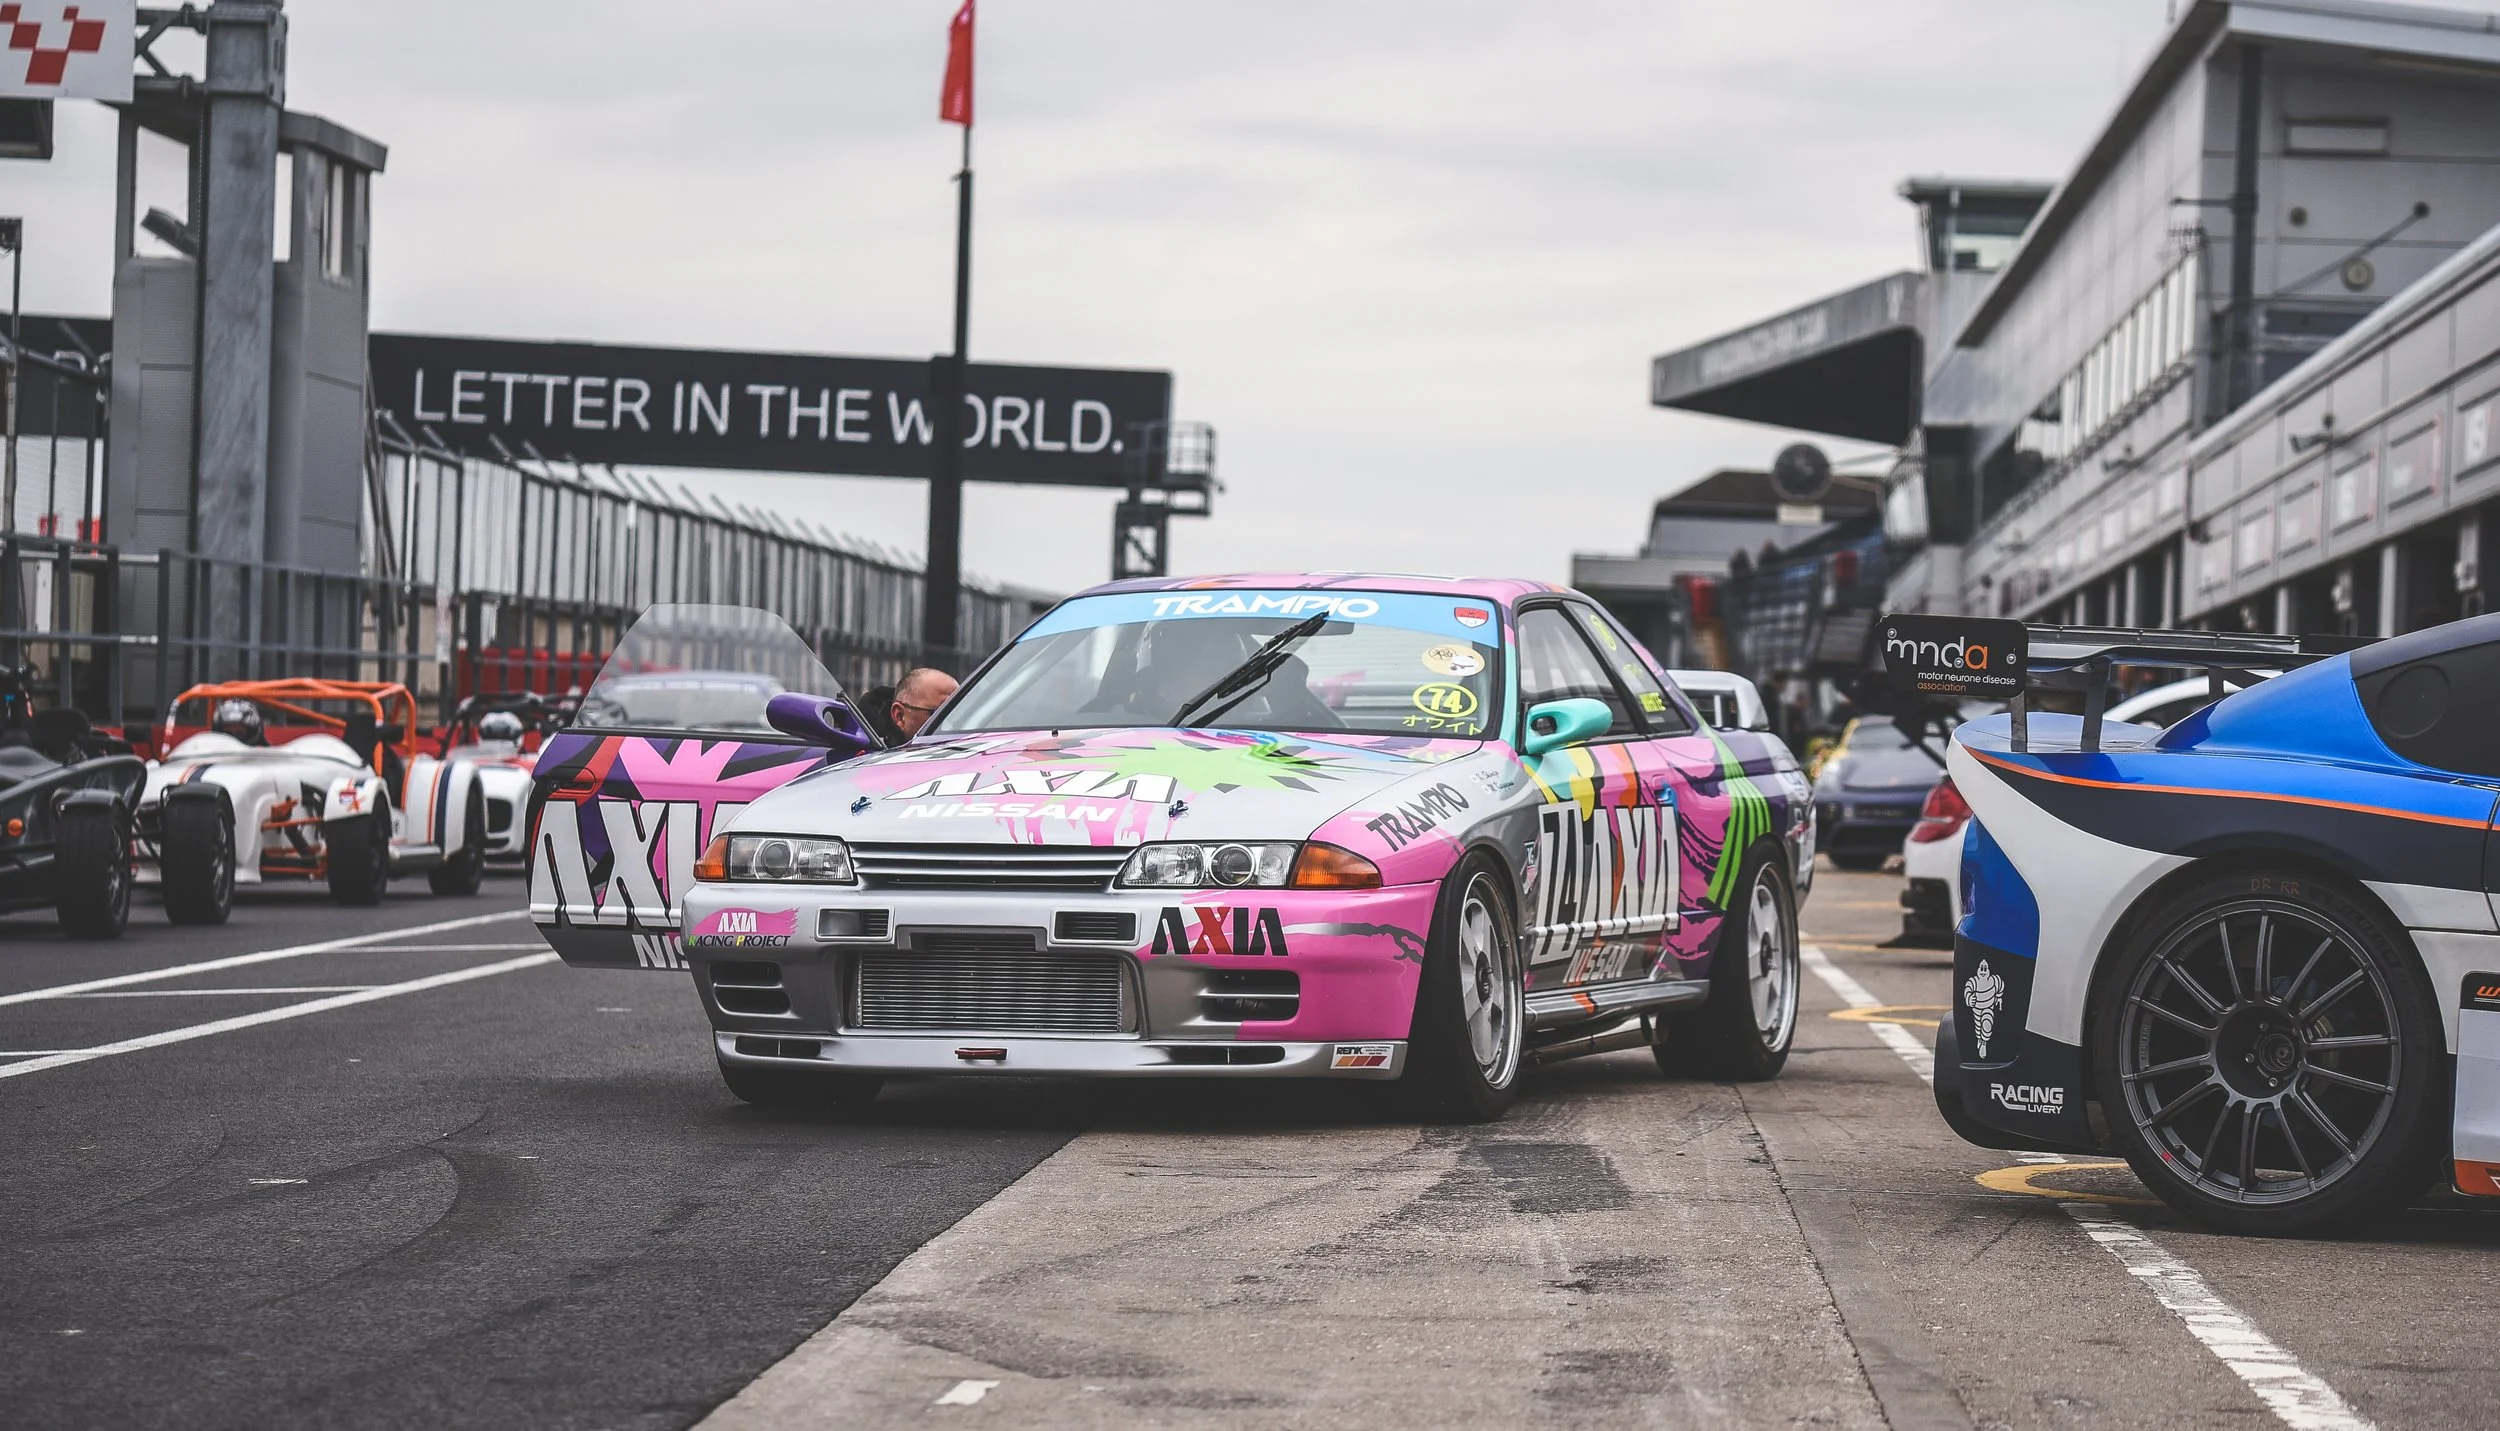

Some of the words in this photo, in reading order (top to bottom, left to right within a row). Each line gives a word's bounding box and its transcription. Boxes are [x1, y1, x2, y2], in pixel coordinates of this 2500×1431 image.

[413, 367, 651, 432] LETTER
[672, 379, 731, 436] IN
[745, 383, 873, 443] THE
[1152, 593, 1380, 618] TRAMPIO
[1887, 635, 1989, 670] mnda
[1917, 671, 1944, 681] motor
[1945, 672, 1981, 683] neurone
[1982, 674, 2017, 685] disease
[1917, 681, 1967, 692] association
[1428, 687, 1463, 713] 74
[898, 802, 1117, 822] NISSAN
[1365, 782, 1470, 852] TRAMPIO
[529, 801, 750, 928] AXI
[1581, 806, 1681, 940] AXIA
[2280, 880, 2300, 895] RR
[717, 912, 758, 933] AXIA
[1150, 906, 1289, 956] AXIA
[688, 934, 734, 947] RACING
[735, 934, 792, 947] PROJECT
[1562, 943, 1634, 984] NISSAN
[1990, 1083, 2064, 1107] RACING
[2027, 1103, 2064, 1115] LIVERY
